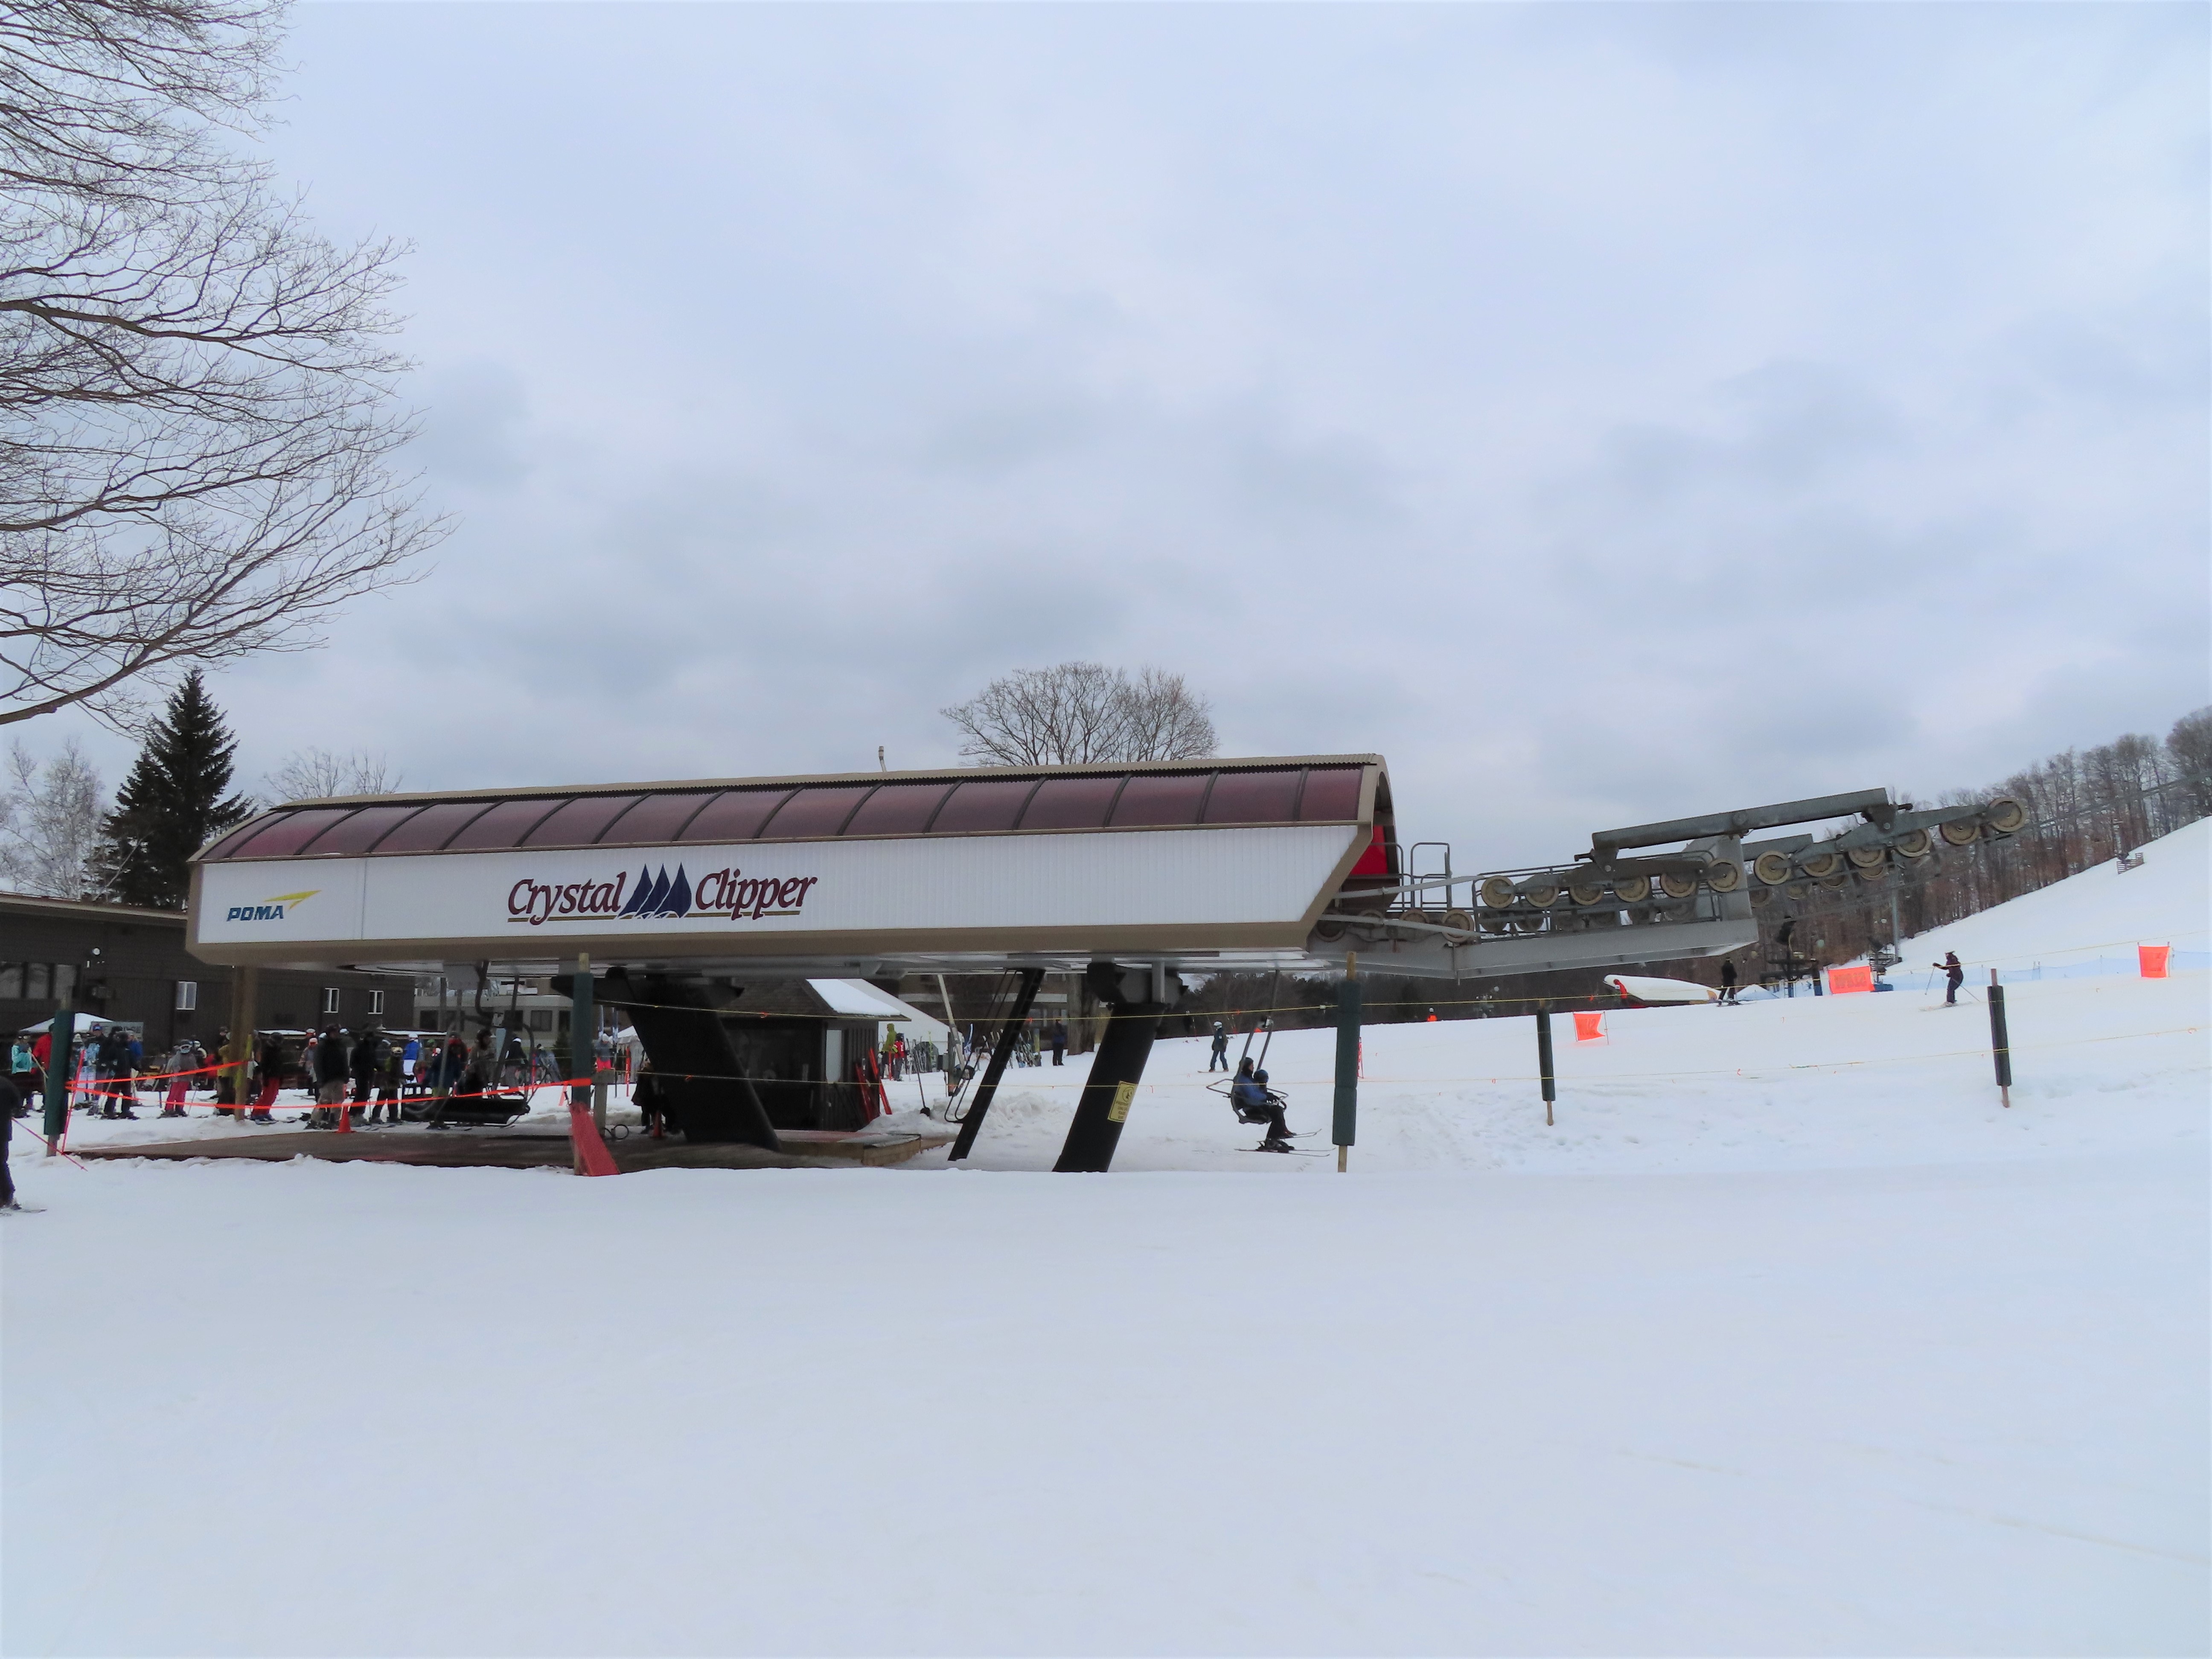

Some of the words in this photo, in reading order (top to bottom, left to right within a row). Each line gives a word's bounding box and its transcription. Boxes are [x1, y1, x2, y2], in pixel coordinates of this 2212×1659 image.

[227, 905, 284, 922] POMA
[508, 871, 627, 926] Crystal
[696, 867, 818, 921] Clipper
